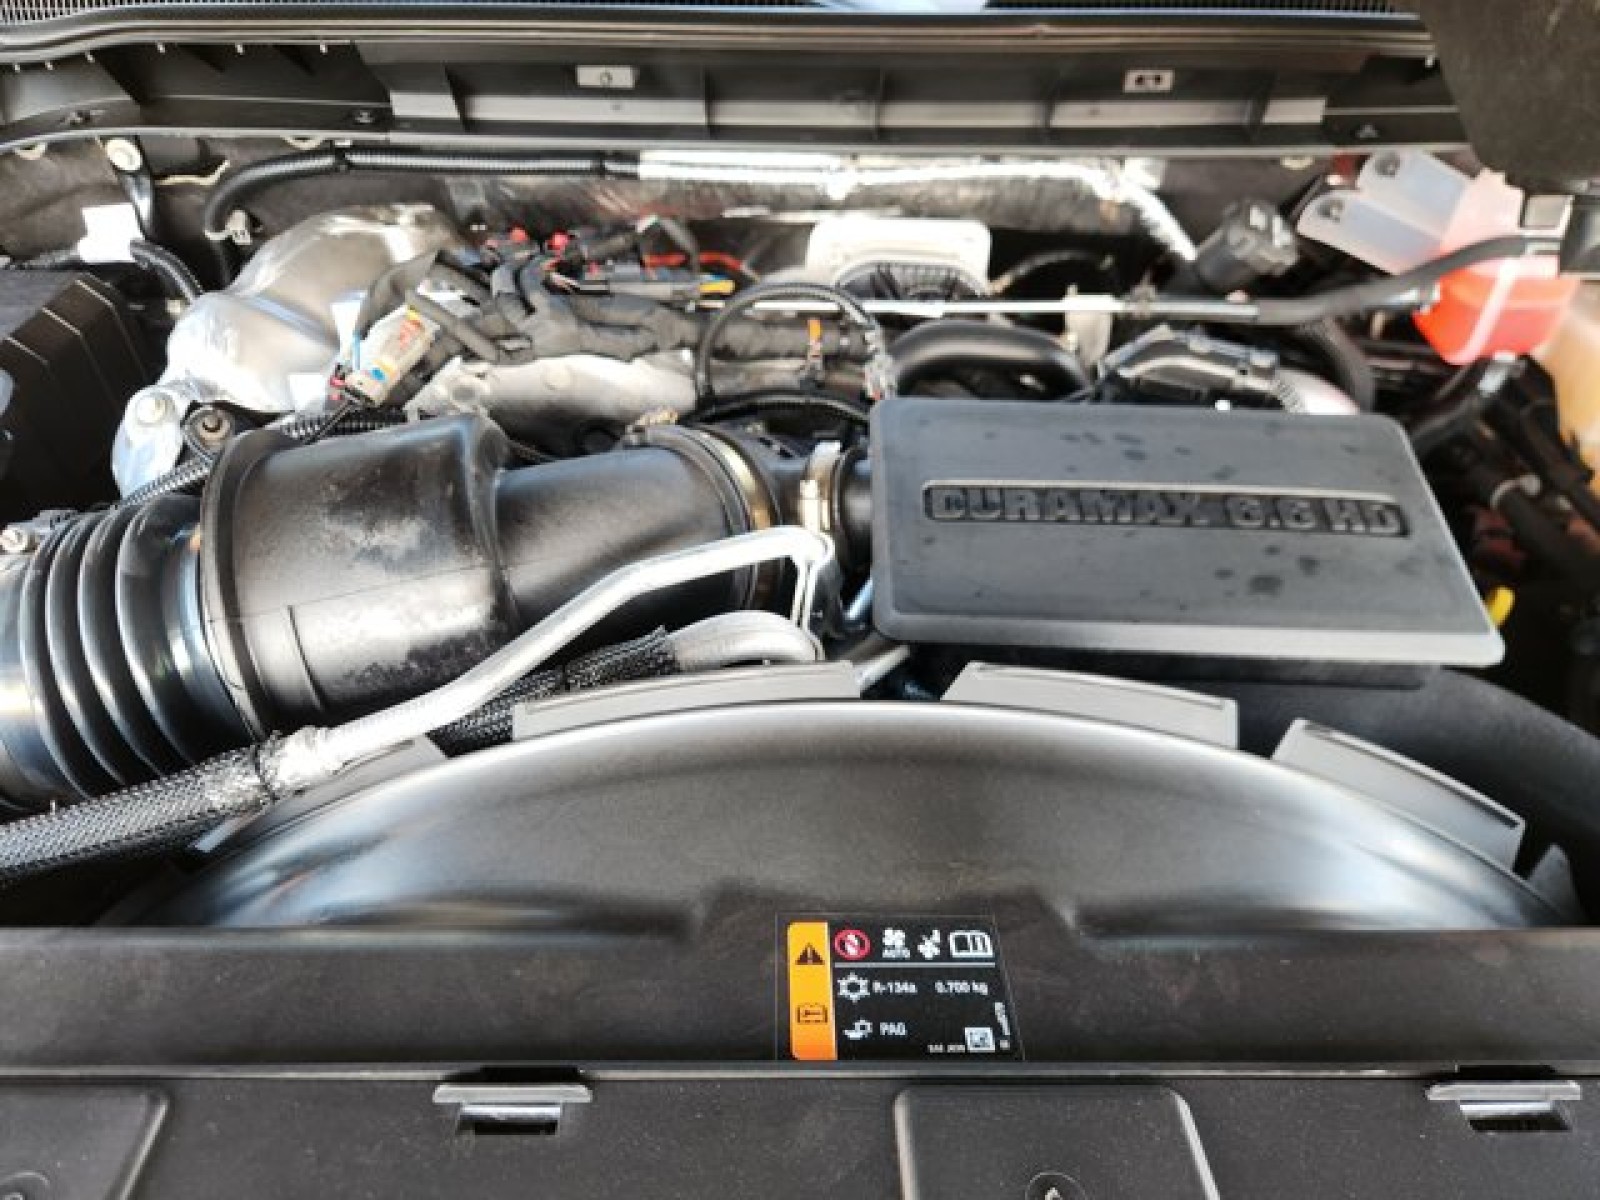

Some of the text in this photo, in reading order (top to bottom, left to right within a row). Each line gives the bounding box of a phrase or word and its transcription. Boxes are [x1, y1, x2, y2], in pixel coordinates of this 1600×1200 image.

[931, 486, 1403, 535] DURAMAX 6.6 HD
